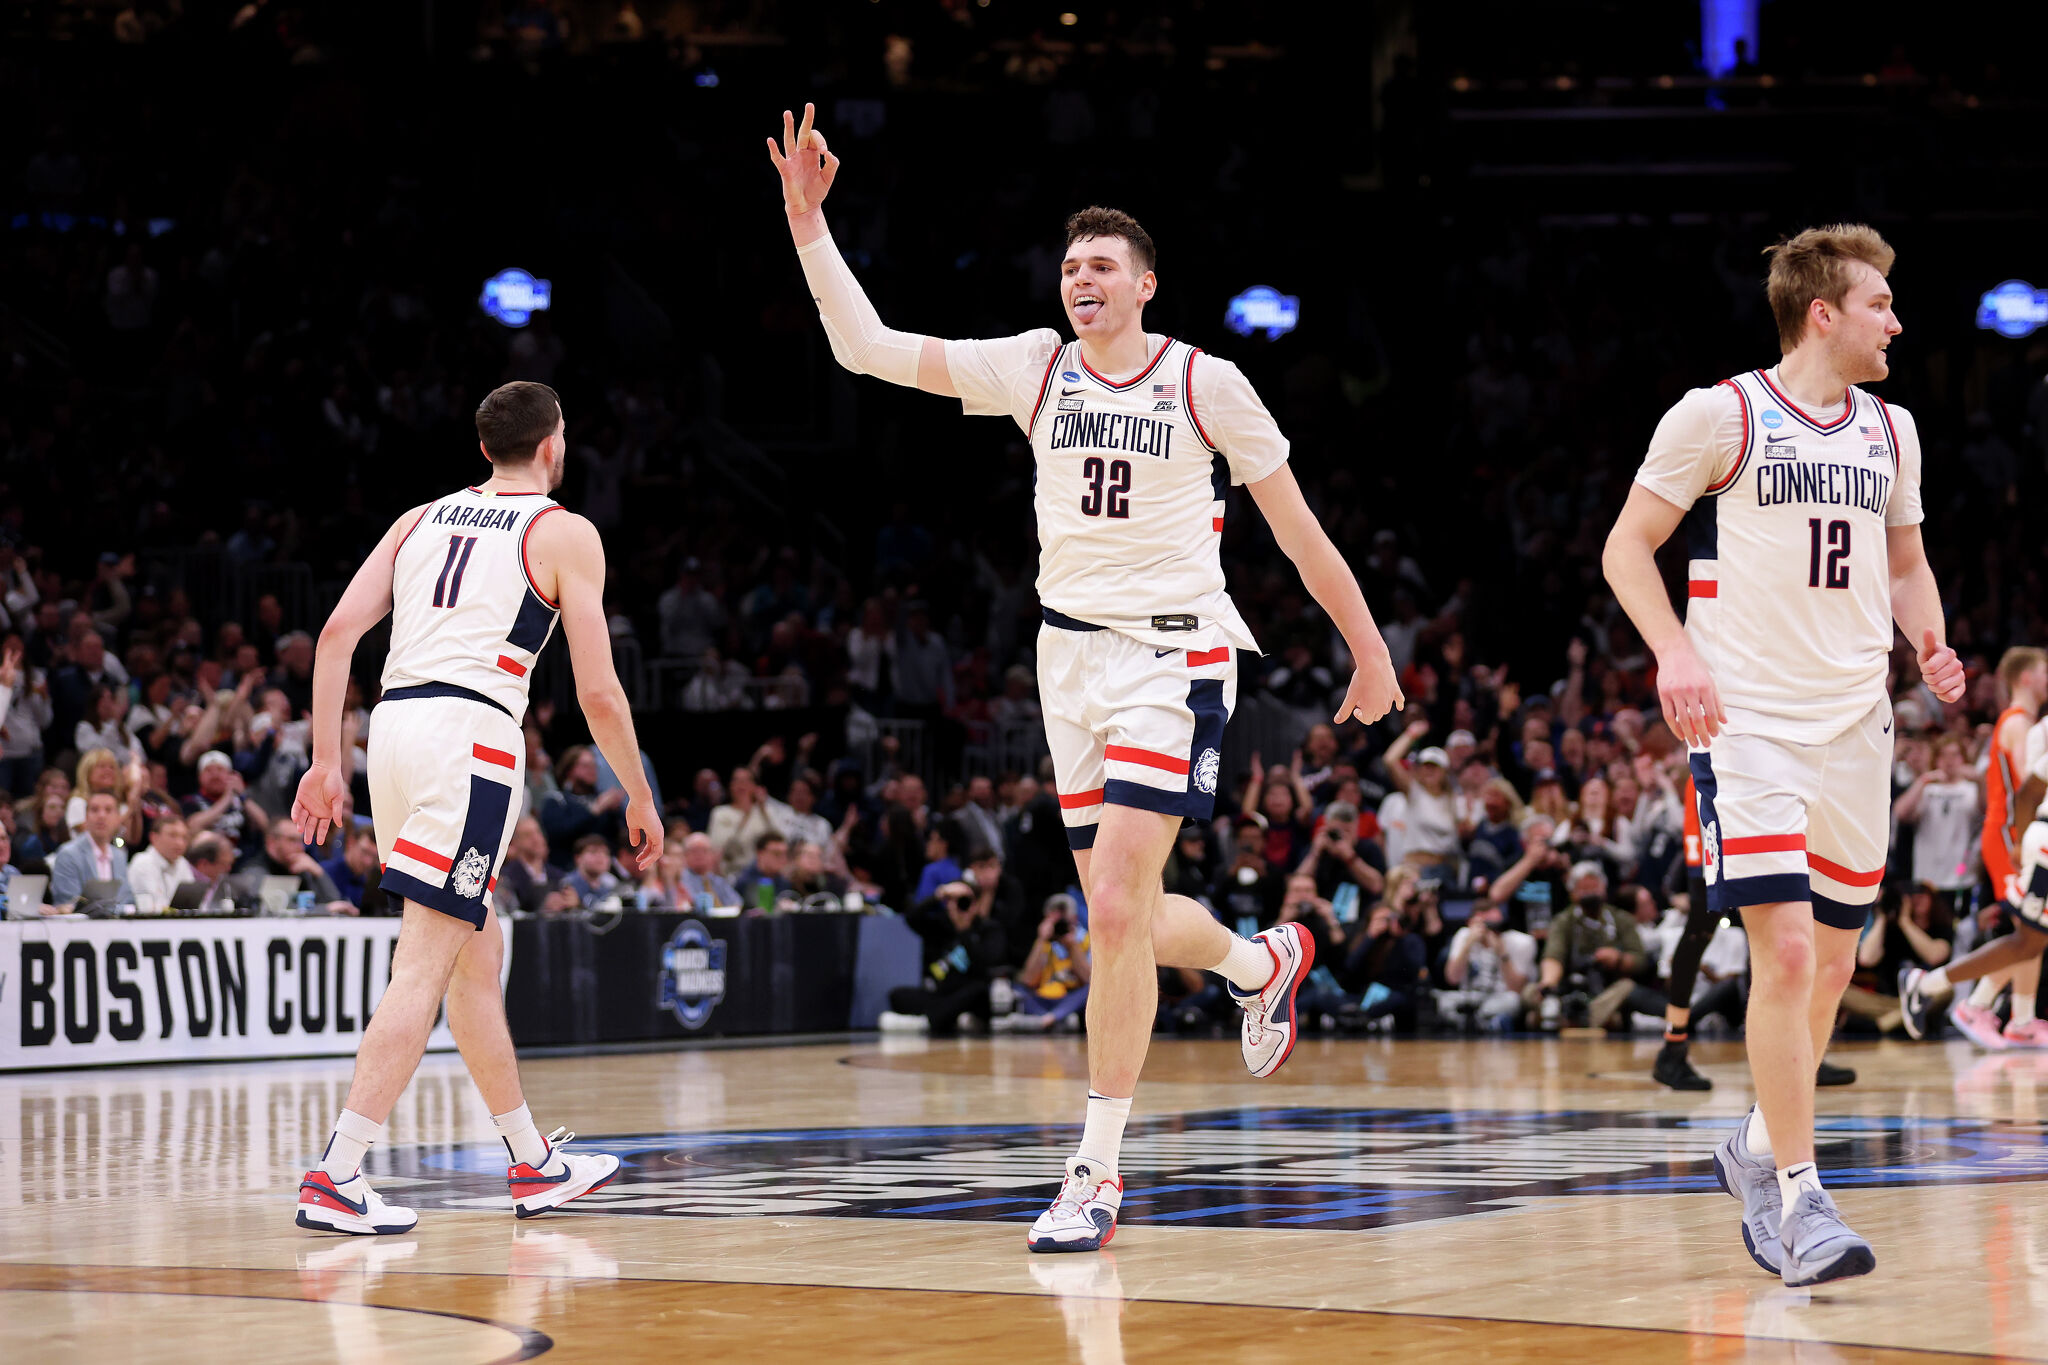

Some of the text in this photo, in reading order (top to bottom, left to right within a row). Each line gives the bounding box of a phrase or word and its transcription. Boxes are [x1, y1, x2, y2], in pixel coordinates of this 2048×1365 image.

[1050, 412, 1175, 460] CONNECTICUT
[432, 504, 520, 532] KARABAN
[1081, 457, 1132, 519] 32
[1757, 462, 1890, 517] CONNECTICUT
[432, 535, 478, 609] 11
[1808, 518, 1851, 589] 12
[21, 936, 450, 1047] BOSTON COLL
